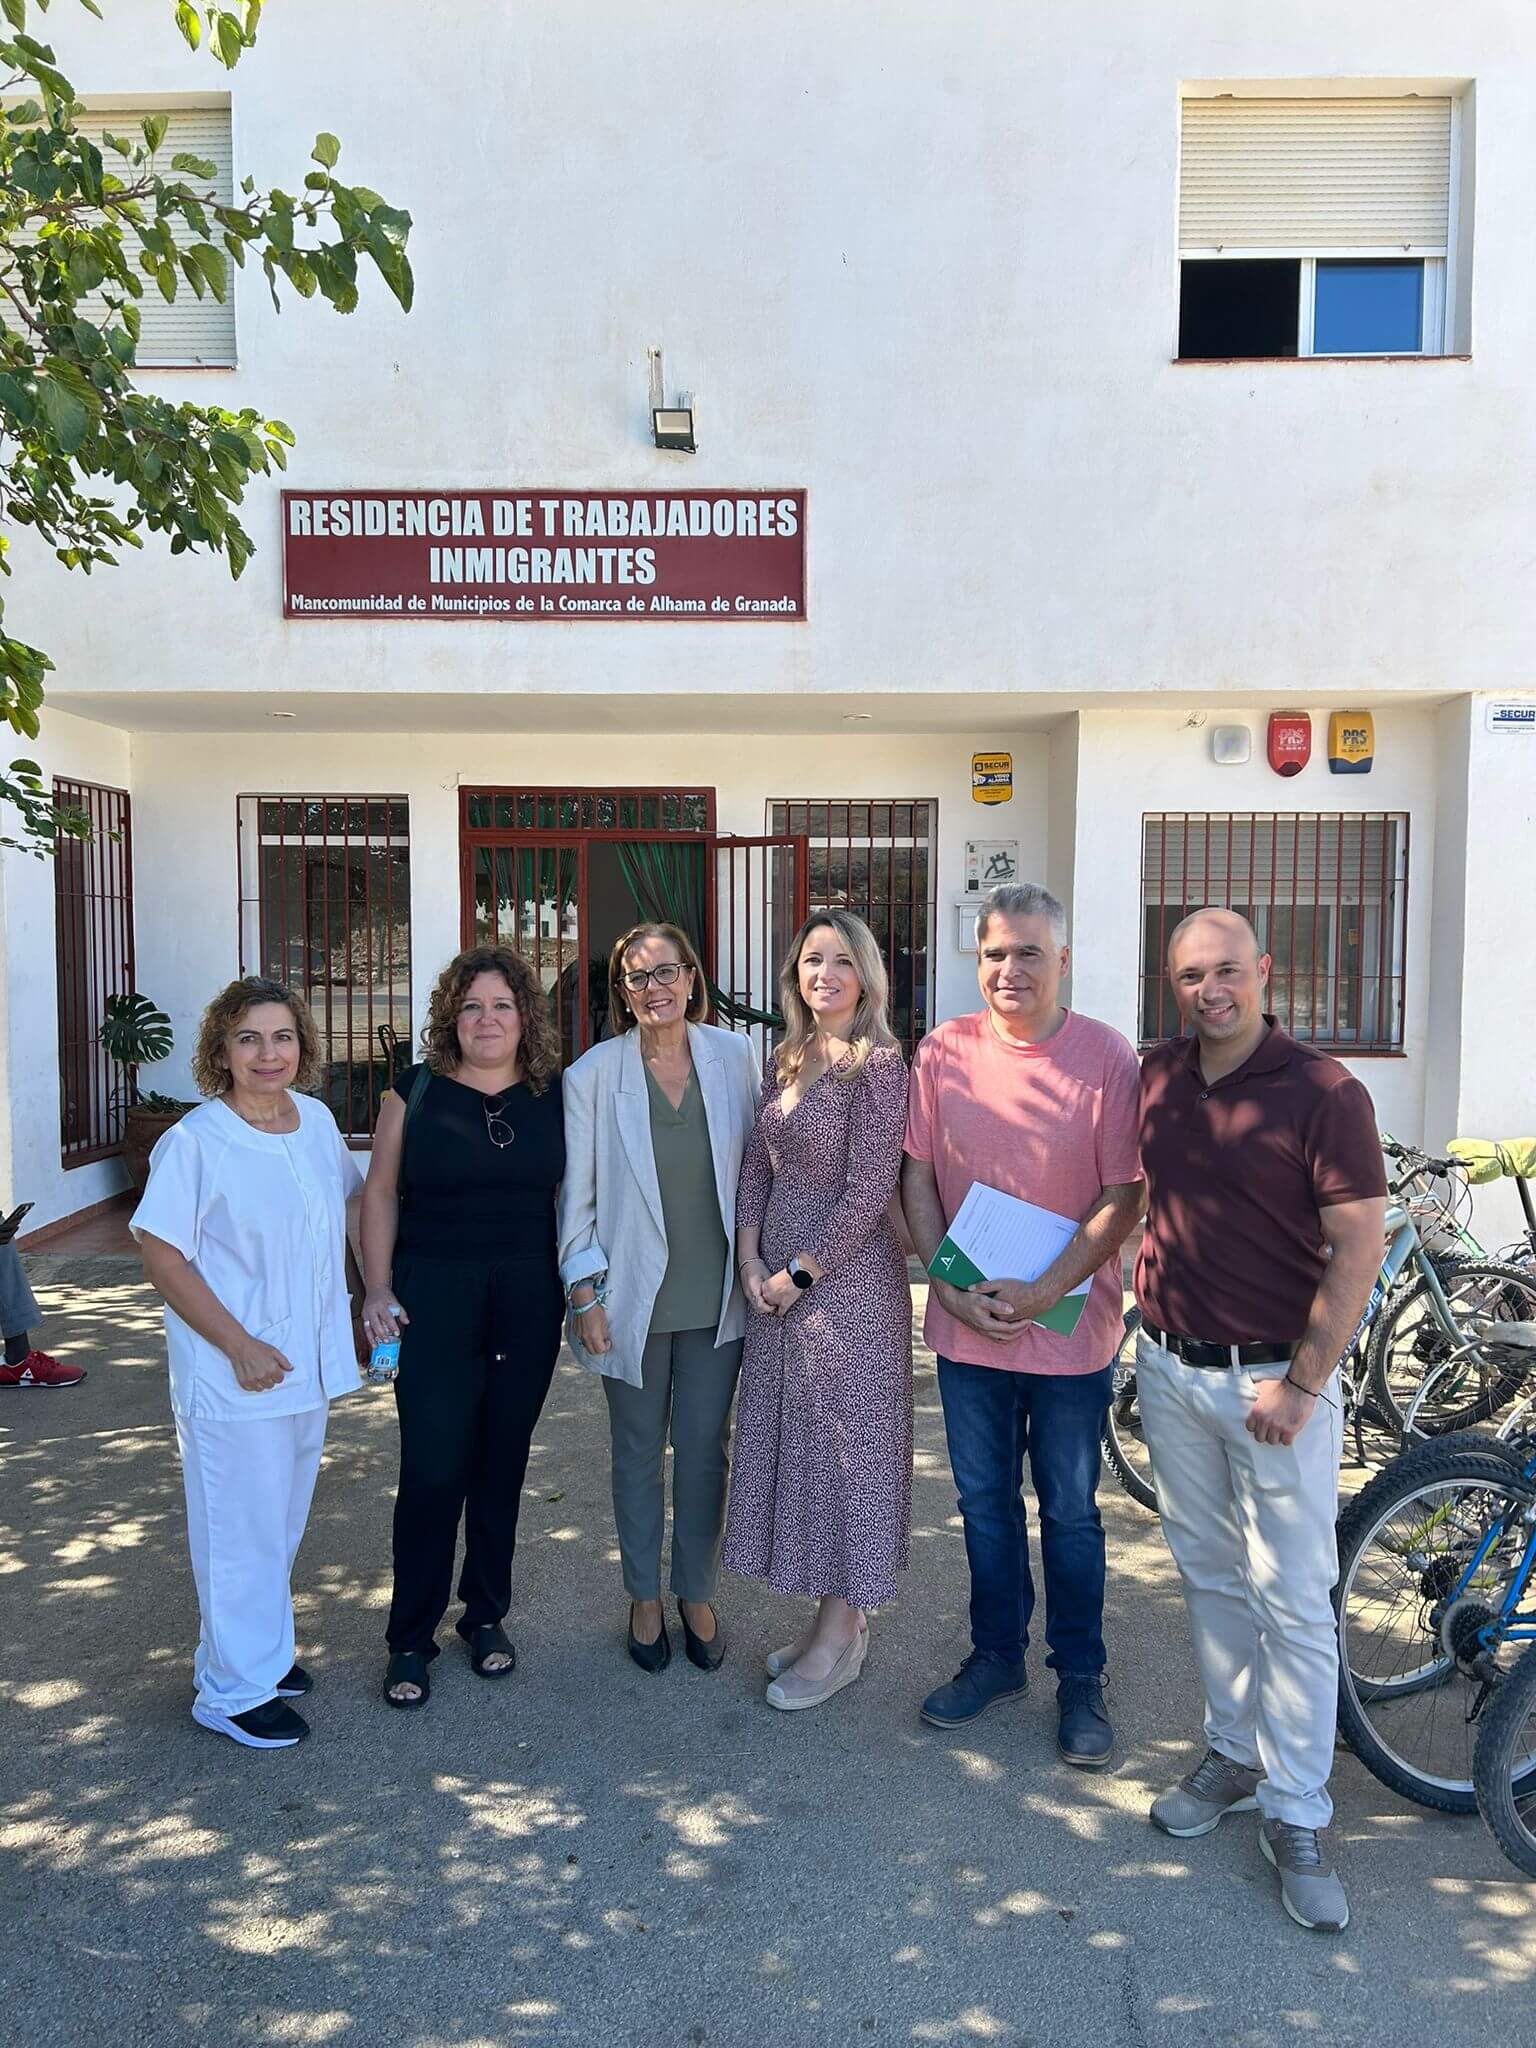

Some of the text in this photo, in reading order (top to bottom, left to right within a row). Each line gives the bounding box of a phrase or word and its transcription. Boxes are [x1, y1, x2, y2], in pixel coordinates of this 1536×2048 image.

[290, 499, 798, 537] RESIDENCIA DE TRABAJADORES
[430, 547, 657, 584] INMIGRANTES
[291, 594, 797, 615] Mancomunidad de Municipios de la Comarca de Alhama de Granada
[1343, 729, 1368, 745] PRS
